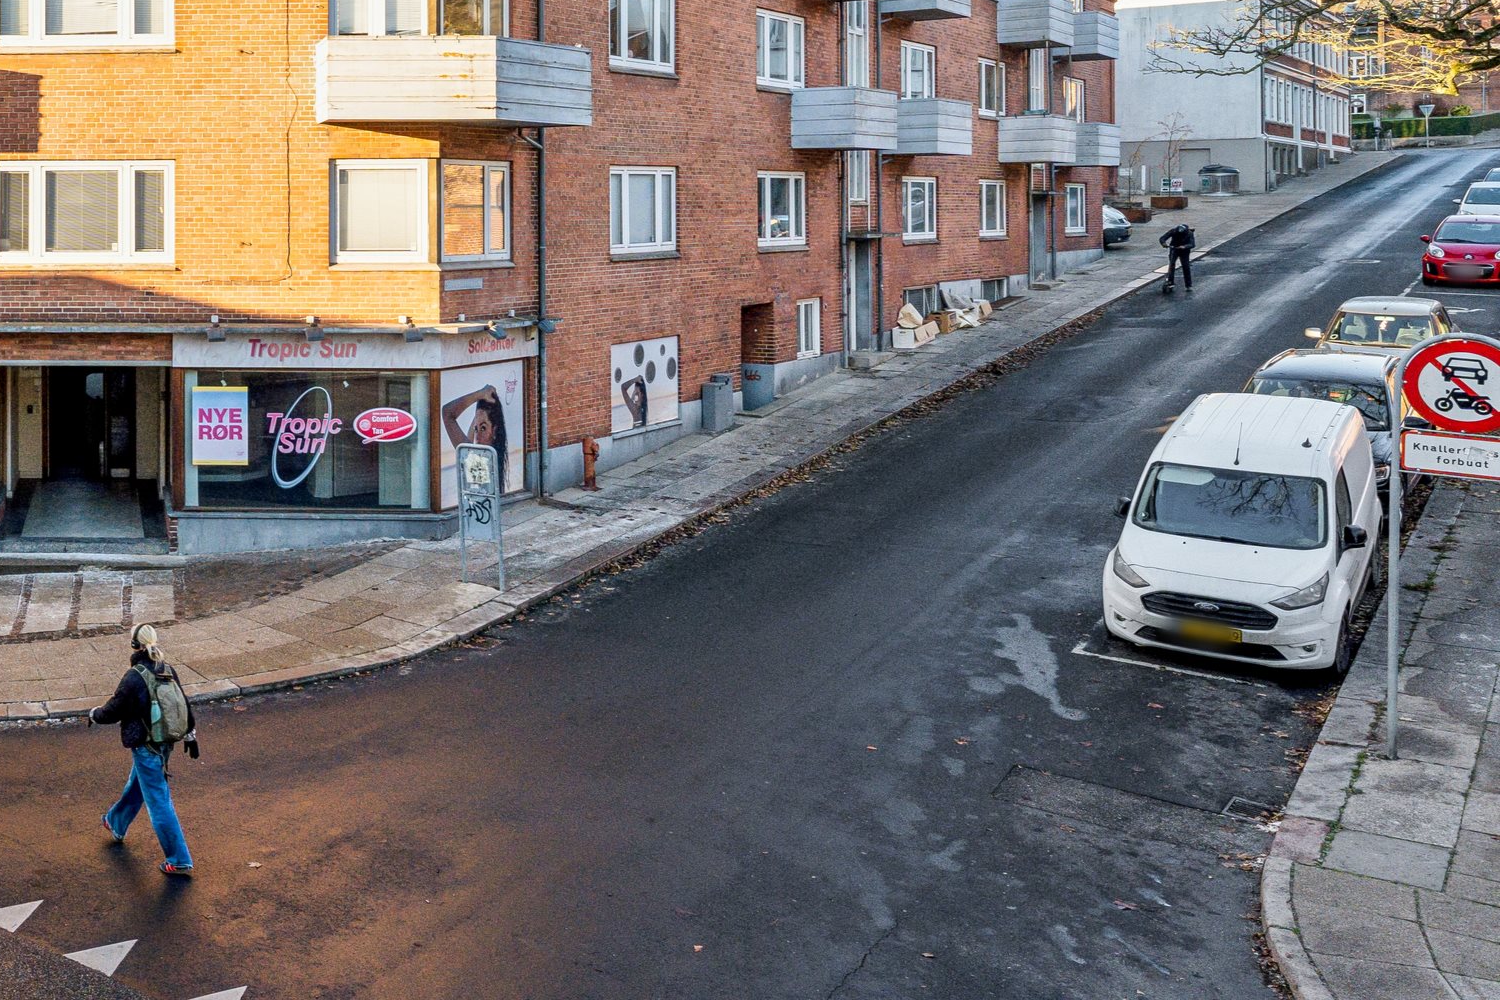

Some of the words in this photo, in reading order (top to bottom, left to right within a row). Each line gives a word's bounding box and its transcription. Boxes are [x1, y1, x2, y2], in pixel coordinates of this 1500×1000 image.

[248, 338, 311, 362] Tropic
[319, 338, 358, 359] Sun
[468, 337, 516, 354] SolCenter
[198, 407, 243, 424] NYE
[371, 415, 399, 423] Comfort
[198, 424, 243, 441] RØR
[266, 412, 343, 439] Tropic
[371, 427, 384, 435] Tan
[277, 431, 327, 455] Sun
